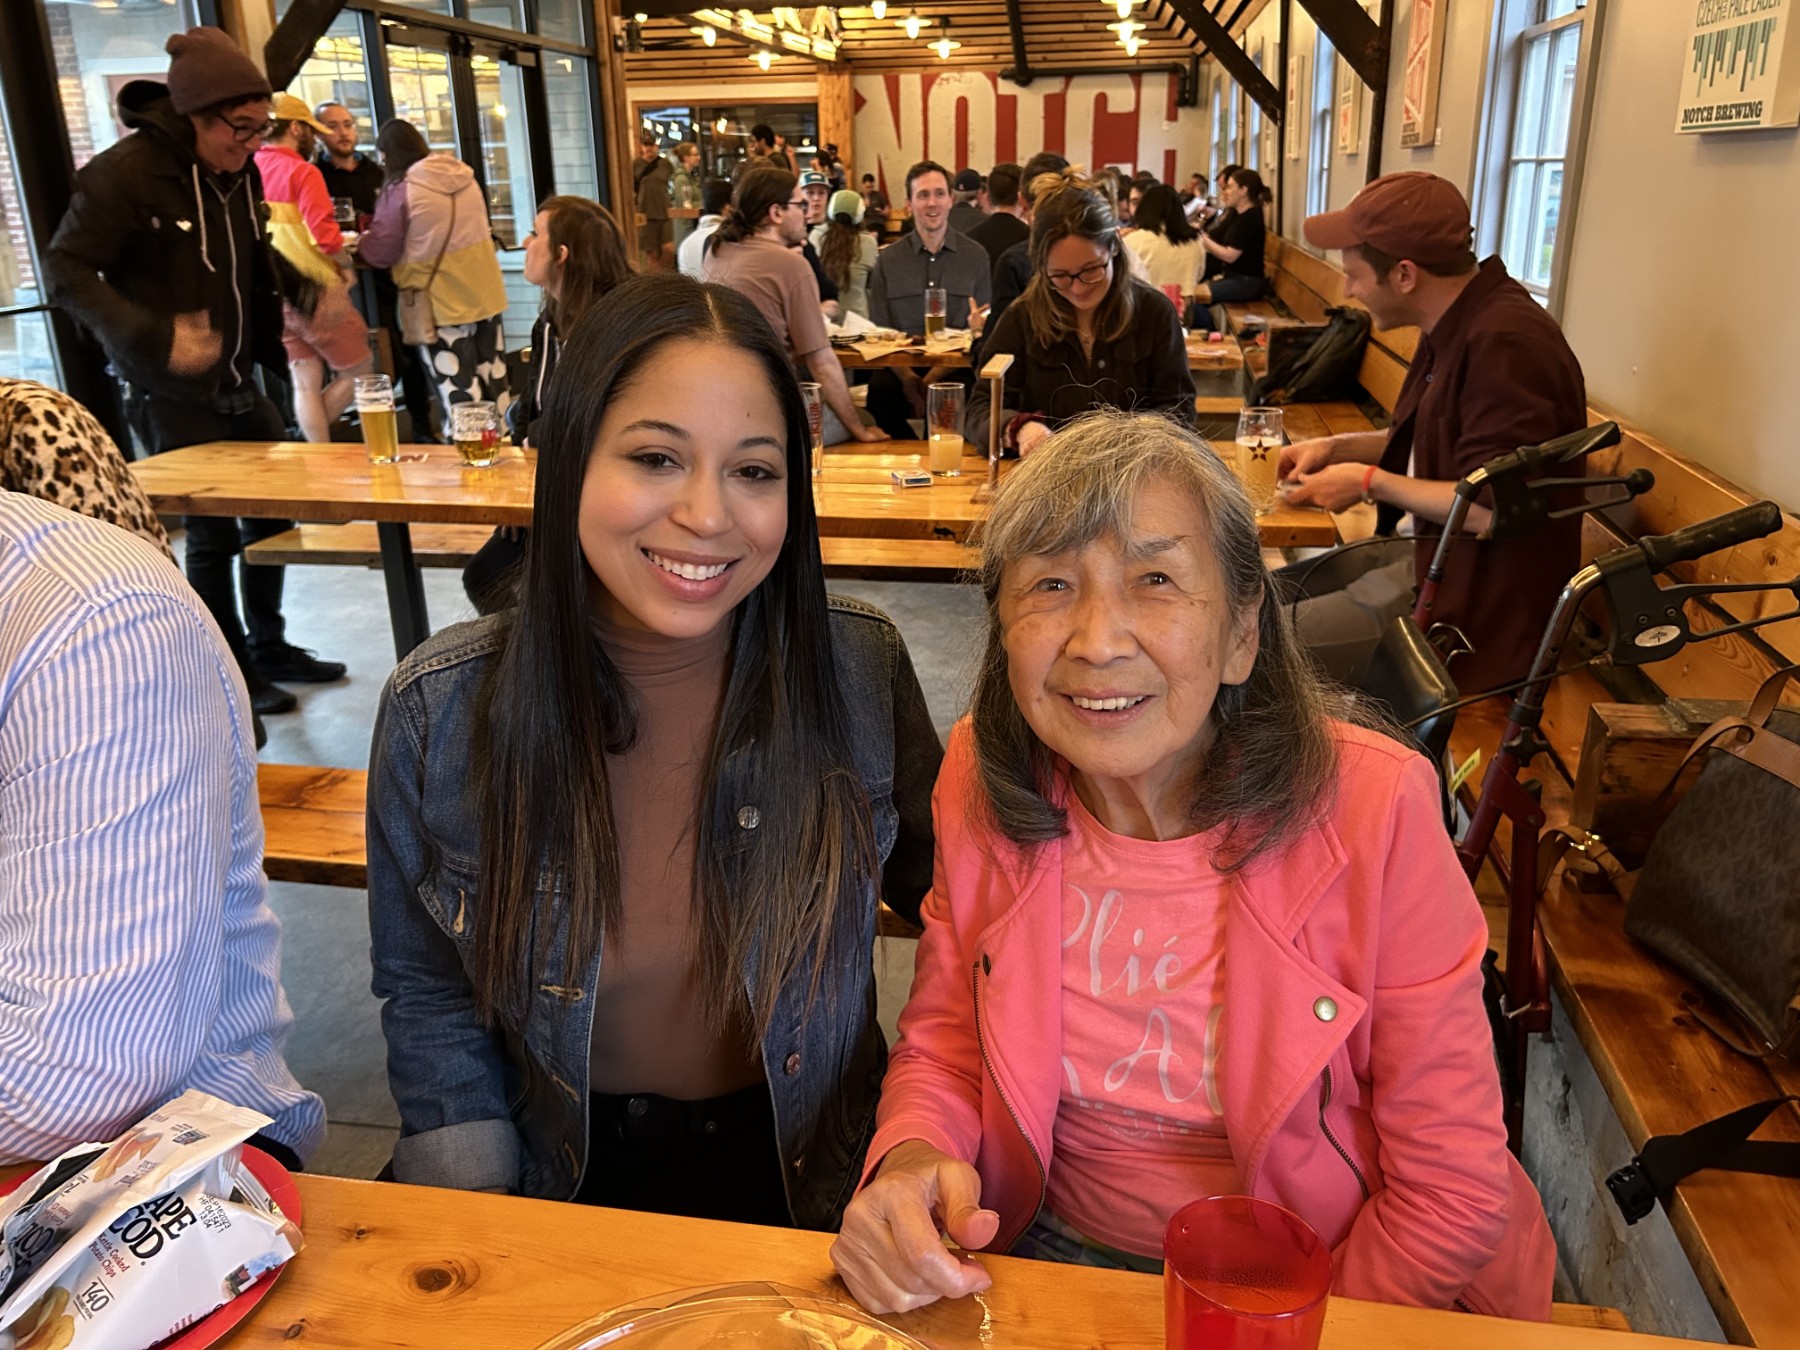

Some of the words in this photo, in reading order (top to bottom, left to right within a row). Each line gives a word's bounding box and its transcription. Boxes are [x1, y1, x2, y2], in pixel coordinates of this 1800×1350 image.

[1682, 105, 1714, 124] NOTCH
[1715, 101, 1763, 120] BREWING
[853, 71, 1205, 209] NOTCH
[109, 1204, 164, 1259] COD
[145, 1191, 197, 1240] APE
[89, 1241, 104, 1262] Potato
[101, 1259, 116, 1278] Chips
[97, 1232, 112, 1252] Kettle
[109, 1248, 130, 1273] Cooked
[82, 1281, 110, 1312] 140
